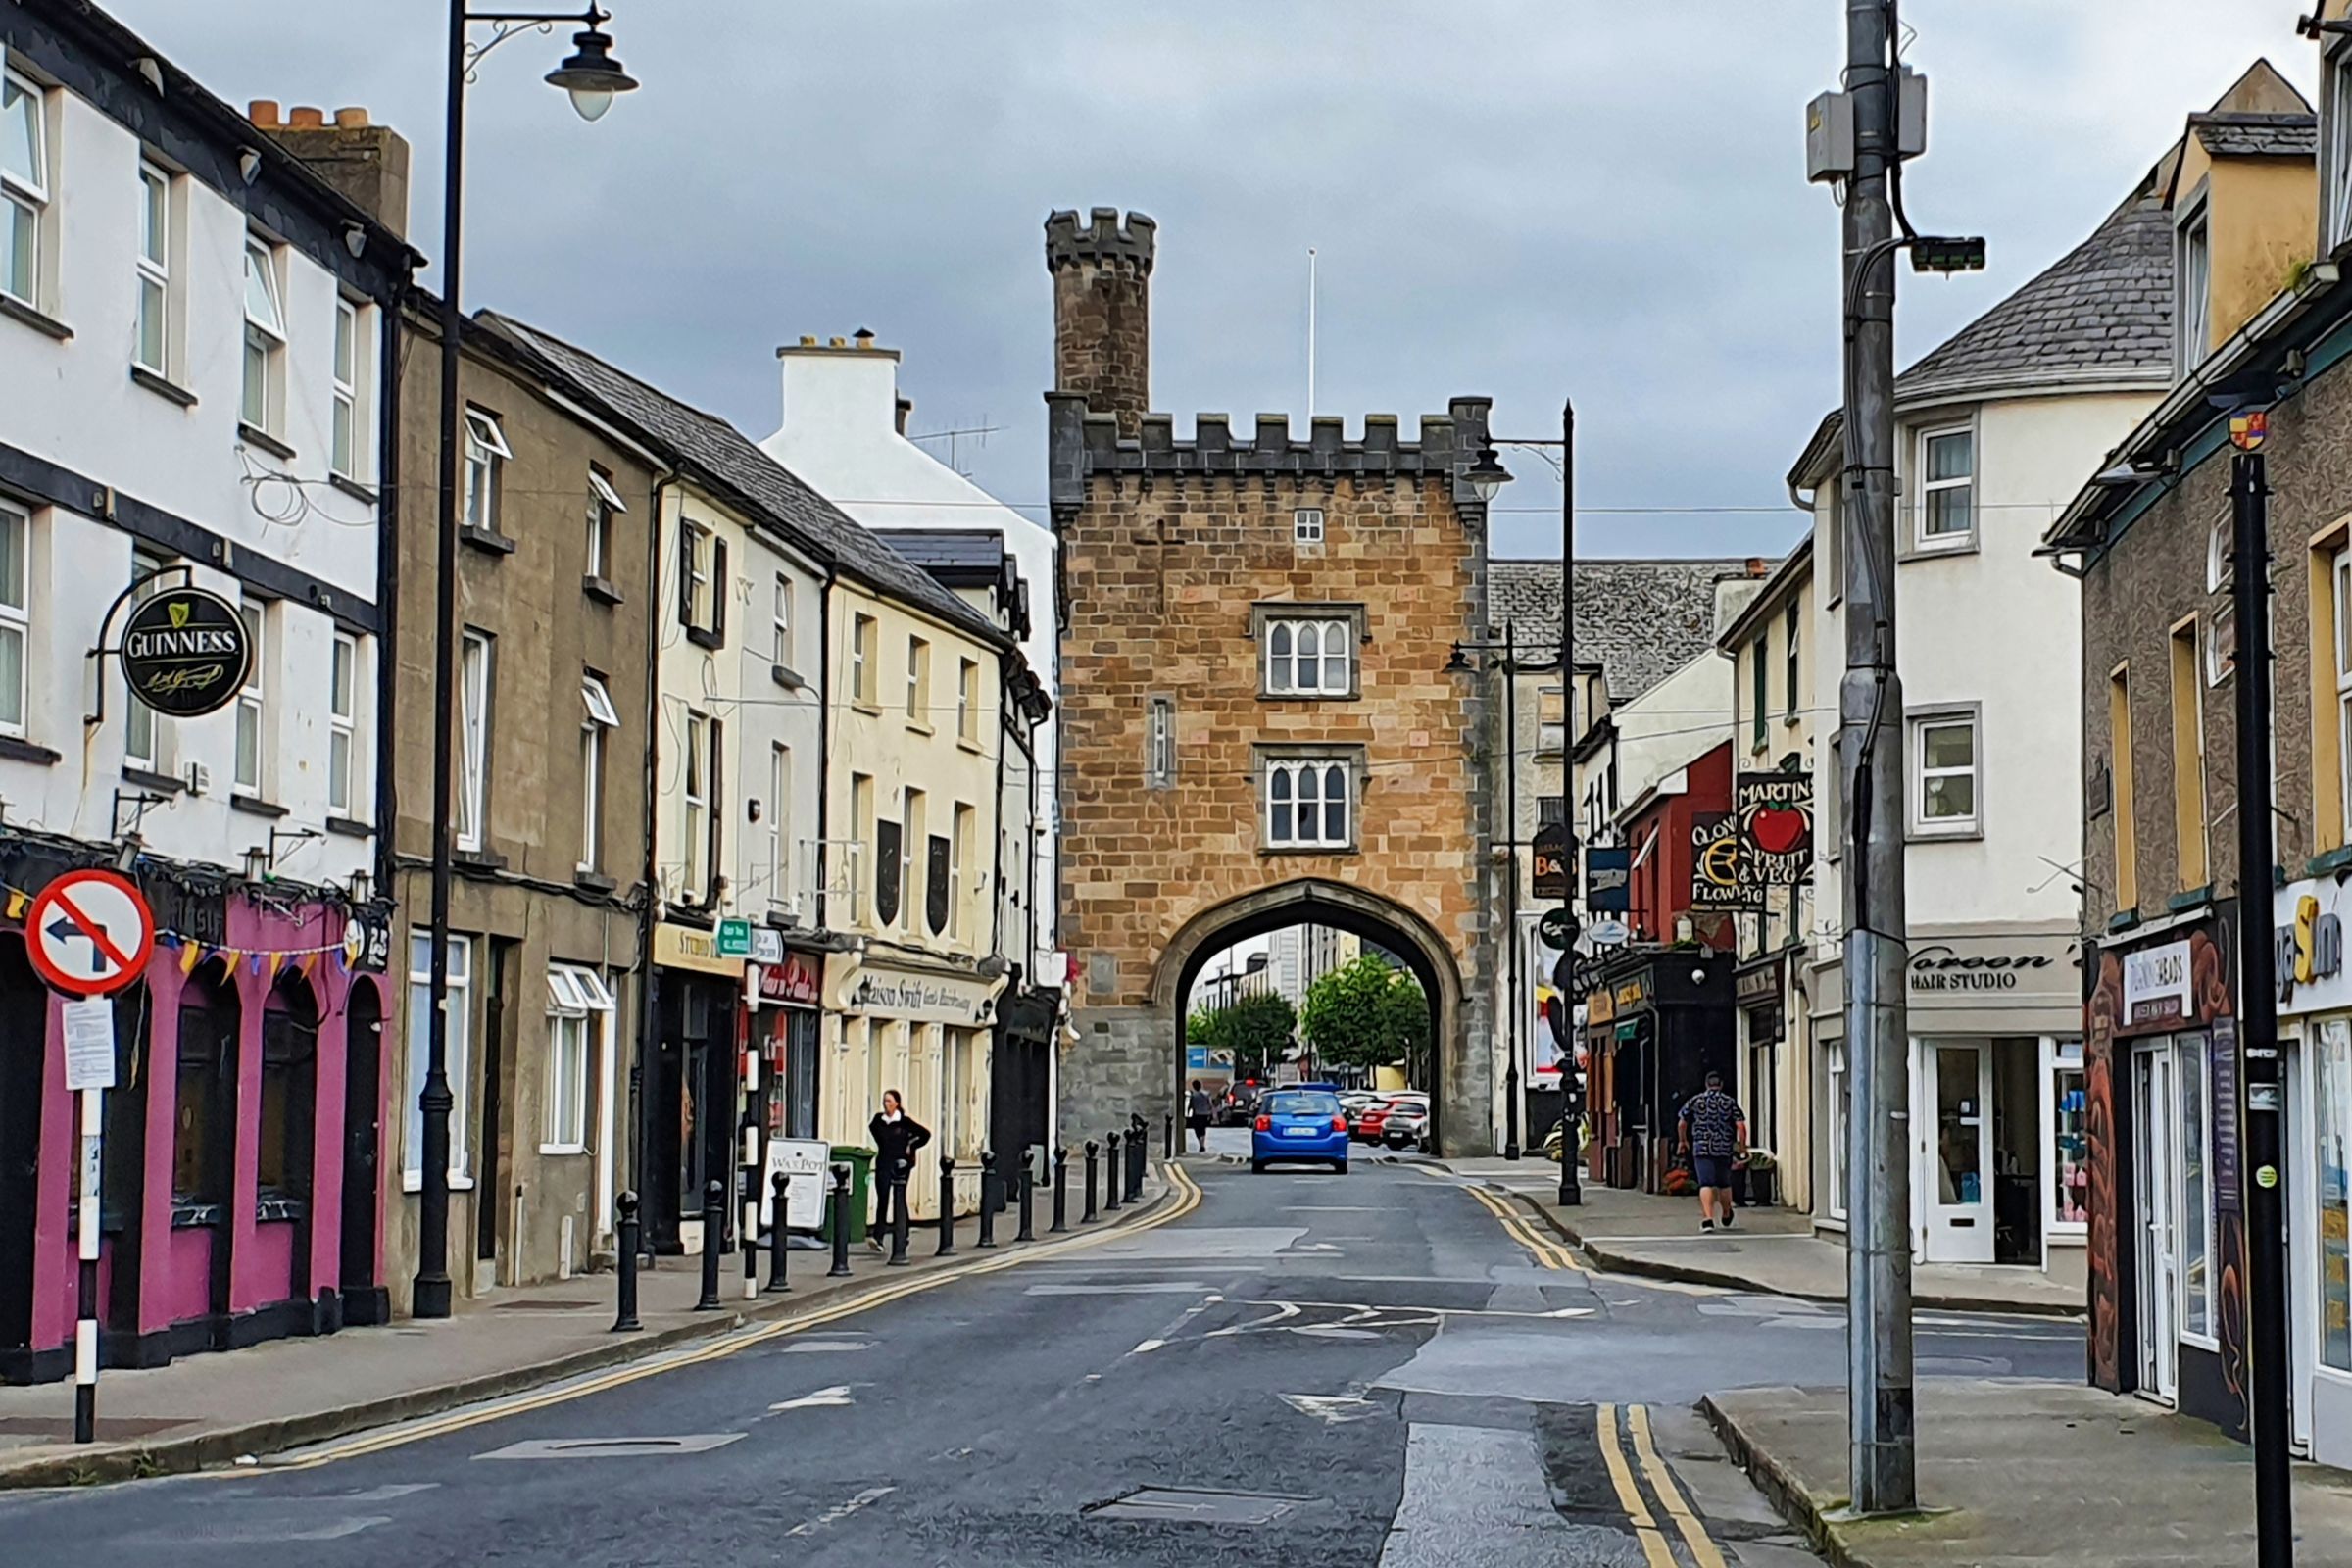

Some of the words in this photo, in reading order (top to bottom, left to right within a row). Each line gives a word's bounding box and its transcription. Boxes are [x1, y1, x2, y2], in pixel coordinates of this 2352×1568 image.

[127, 630, 236, 658] GUINNESS
[1739, 778, 1813, 808] MARTIN
[1753, 848, 1808, 870] FRUIT
[1739, 863, 1751, 882] &
[1753, 866, 1797, 883] VEG
[1911, 973, 1946, 990] HAIR
[1949, 972, 2017, 990] STUDIO
